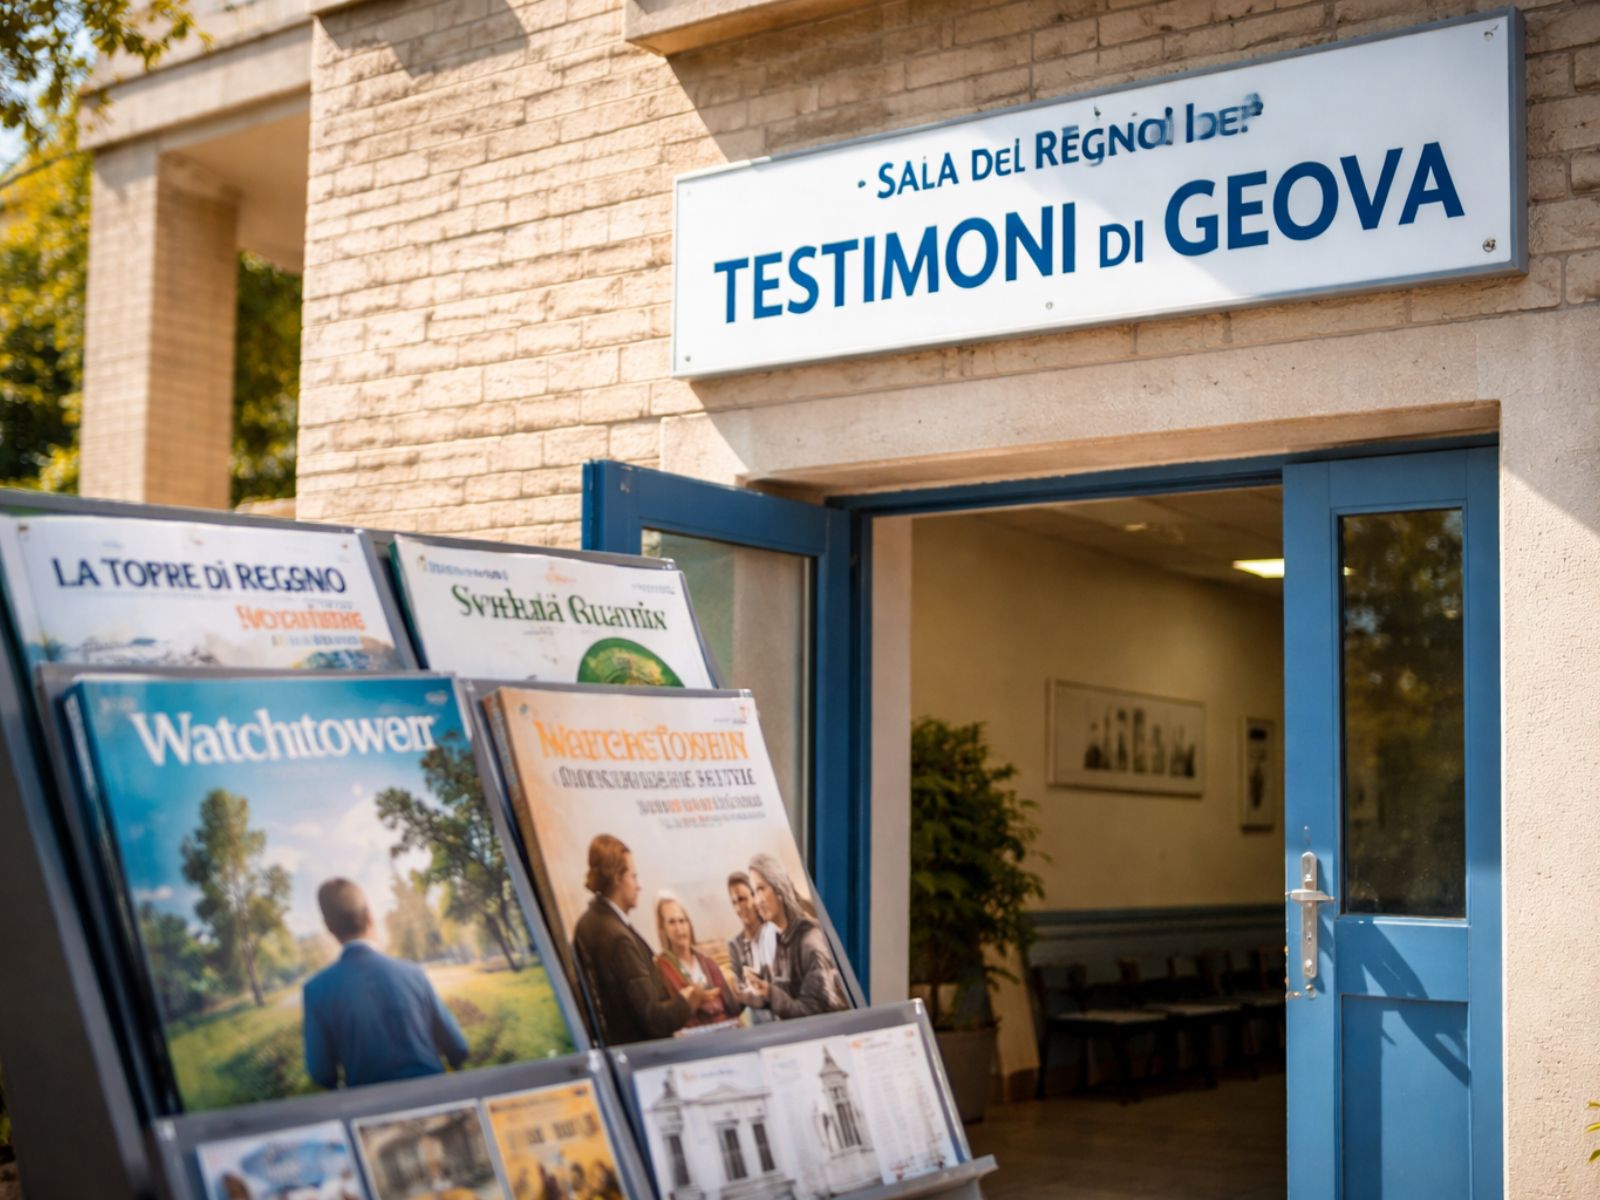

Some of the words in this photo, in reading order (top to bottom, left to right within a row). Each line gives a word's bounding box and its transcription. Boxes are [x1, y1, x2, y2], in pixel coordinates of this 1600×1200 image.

[713, 201, 1077, 324] TESTIMONI
[1099, 219, 1144, 269] DI
[1164, 140, 1465, 257] GEOVA
[51, 557, 101, 589] LA
